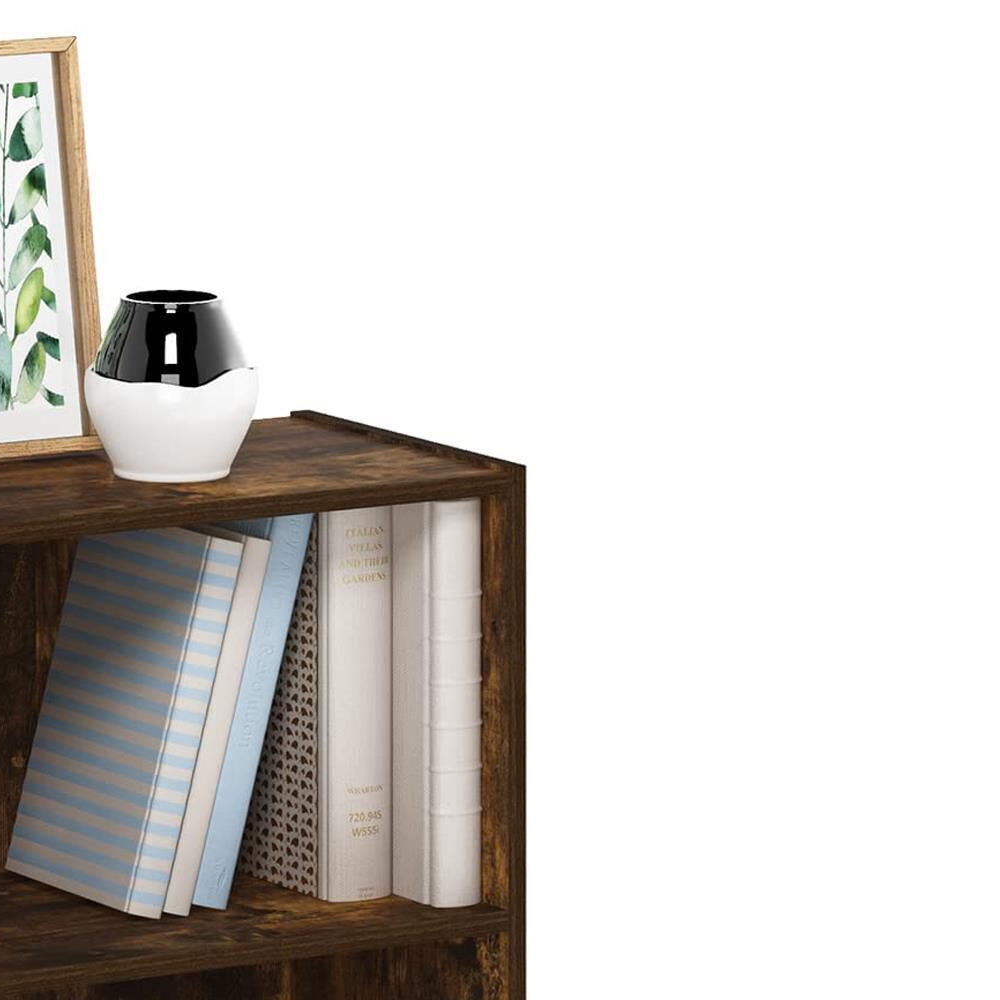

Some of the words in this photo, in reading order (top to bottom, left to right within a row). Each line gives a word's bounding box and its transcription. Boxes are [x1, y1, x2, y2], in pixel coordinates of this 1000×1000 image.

[345, 526, 384, 537] ITALIAN
[347, 544, 384, 553] VILLAS
[339, 559, 361, 569] AND
[342, 572, 386, 584] GARDENS
[349, 810, 383, 823] 720.945
